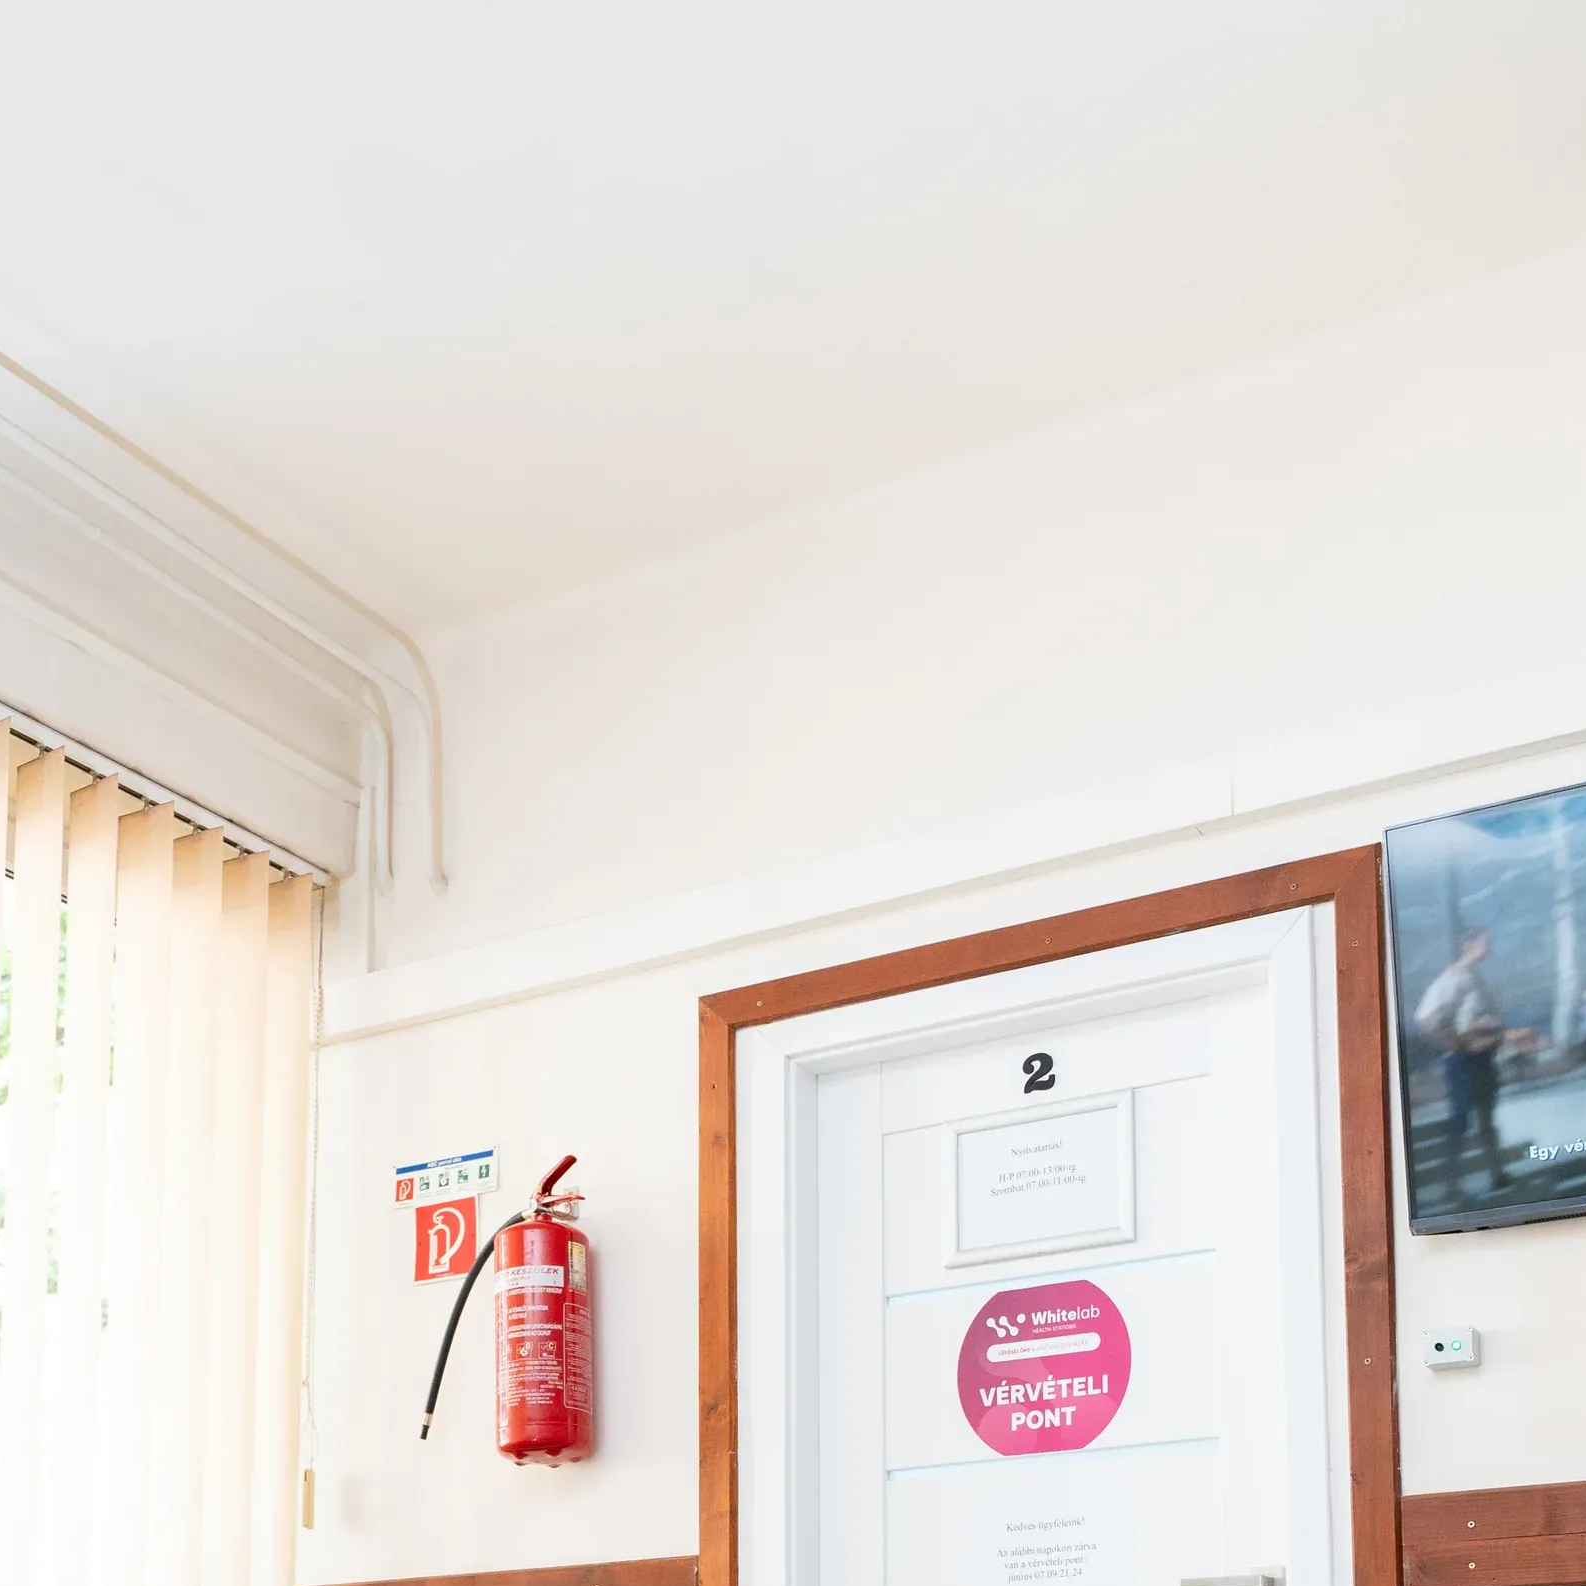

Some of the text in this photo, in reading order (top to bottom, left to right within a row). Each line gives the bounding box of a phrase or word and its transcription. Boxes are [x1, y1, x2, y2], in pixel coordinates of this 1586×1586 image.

[1022, 1052, 1056, 1094] 2
[1529, 1145, 1560, 1161] Egy
[990, 1183, 1025, 1197] Szombat
[1030, 1304, 1101, 1326] Whitelab
[1052, 1323, 1077, 1332] STATIONS
[979, 1374, 1109, 1407] VÉRVÉTELI
[1010, 1406, 1077, 1432] PONT
[1006, 1522, 1037, 1532] Kedves
[996, 1549, 1008, 1558] Az
[1036, 1544, 1072, 1556] napokon
[1004, 1561, 1019, 1569] van
[1006, 1571, 1033, 1584] június
